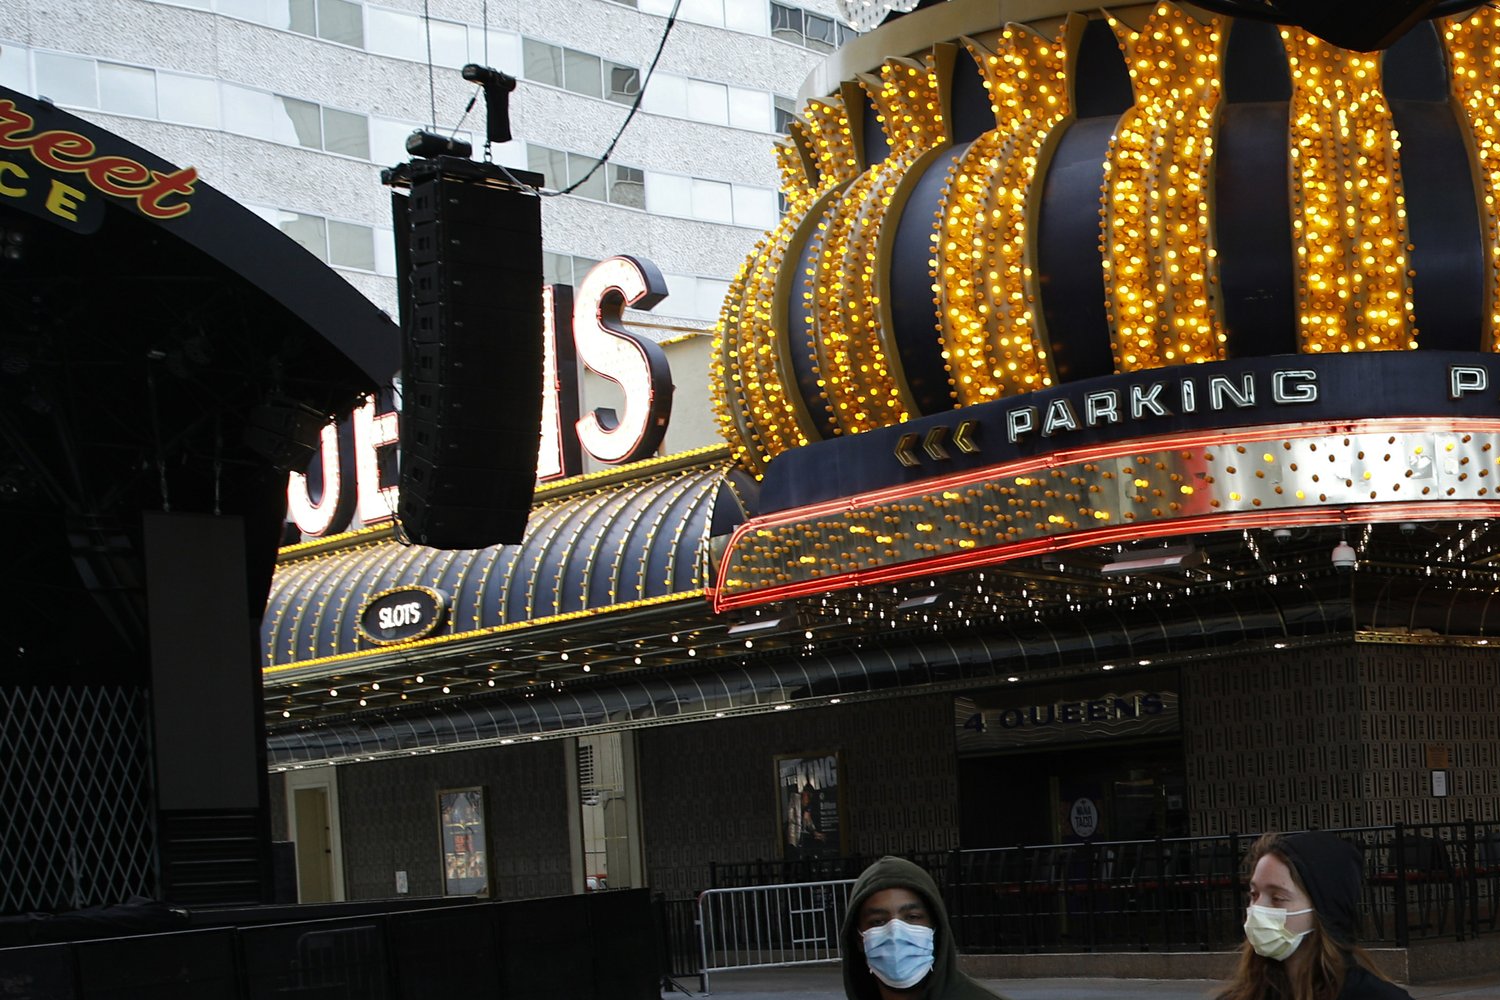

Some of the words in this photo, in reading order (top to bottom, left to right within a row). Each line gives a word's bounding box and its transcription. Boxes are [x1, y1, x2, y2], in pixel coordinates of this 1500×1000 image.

[1006, 368, 1319, 444] PARKING
[378, 602, 421, 630] SLOTS
[964, 711, 987, 733] 4
[999, 692, 1168, 729] QUEENS
